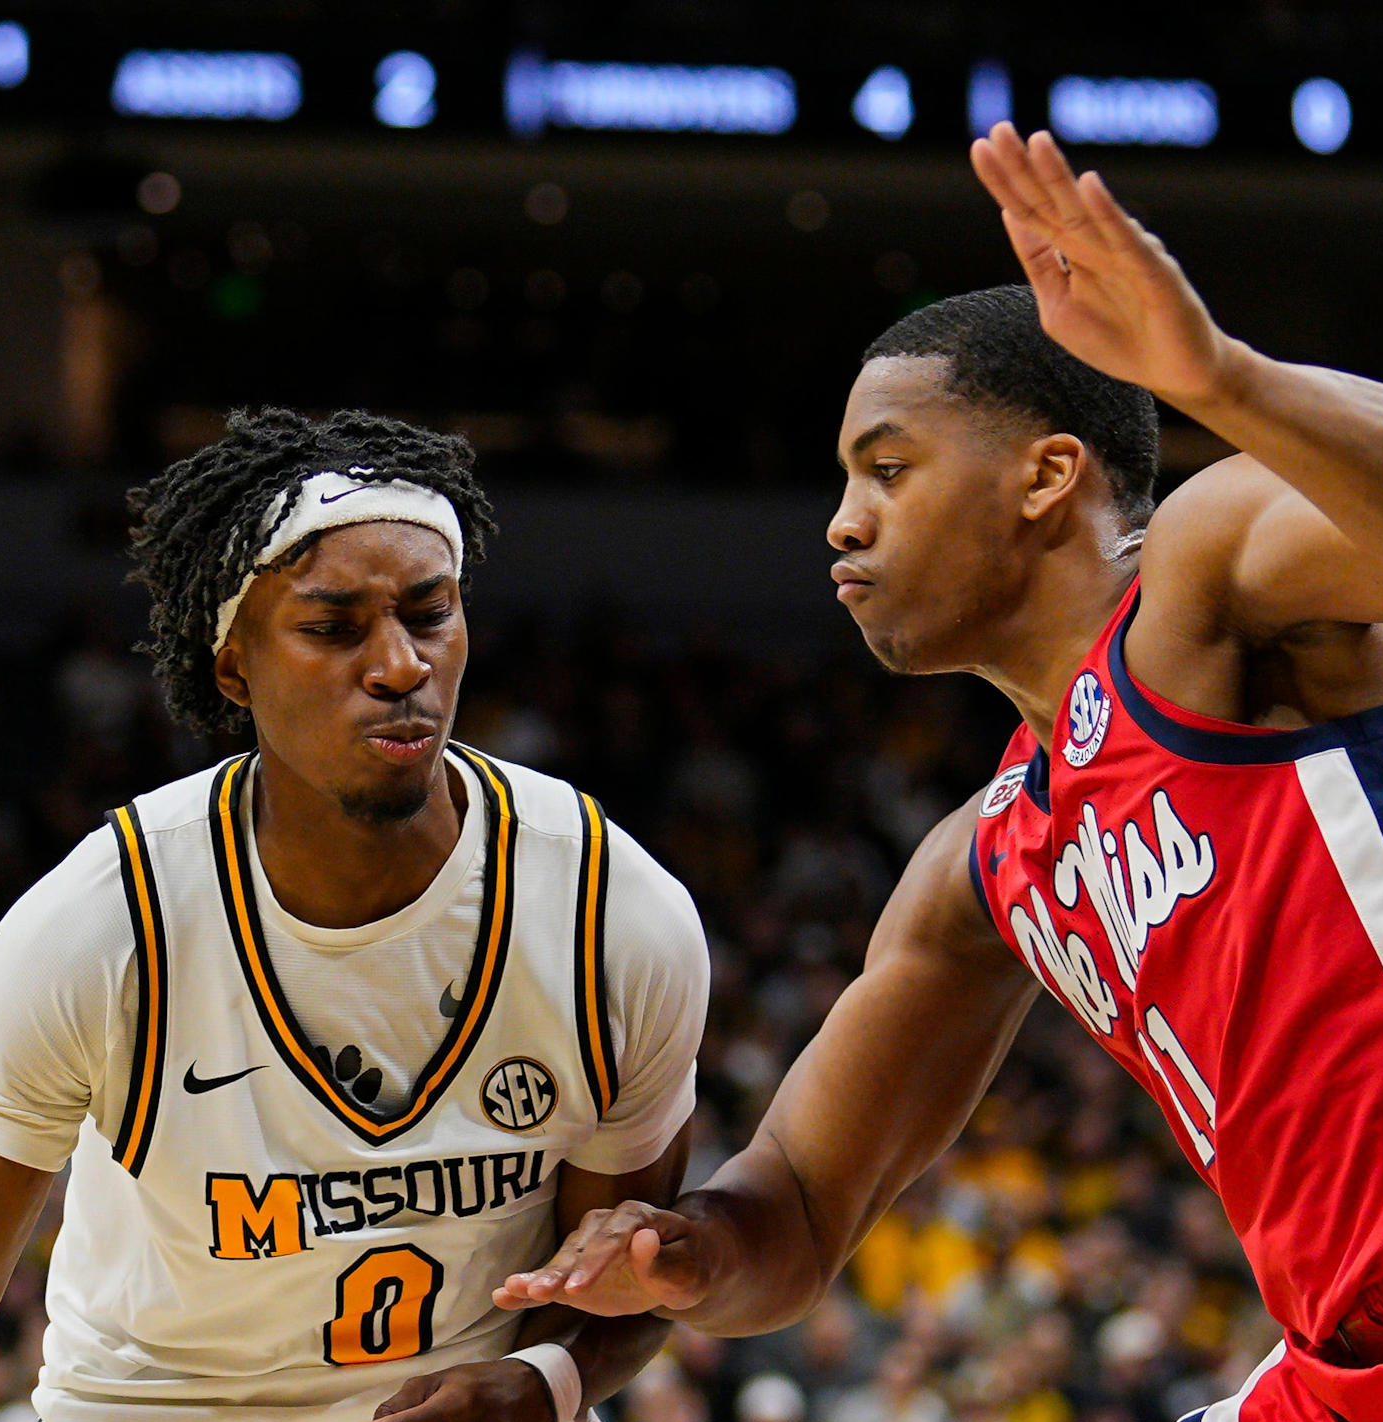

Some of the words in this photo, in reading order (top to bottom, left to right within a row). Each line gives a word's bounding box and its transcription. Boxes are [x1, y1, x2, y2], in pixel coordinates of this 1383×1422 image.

[1069, 672, 1103, 743] SEC
[1053, 787, 1217, 994] Miss
[485, 1062, 553, 1128] SEC
[1136, 1002, 1217, 1169] 11
[205, 1149, 545, 1260] MISSOURI
[323, 1243, 444, 1366] 0
